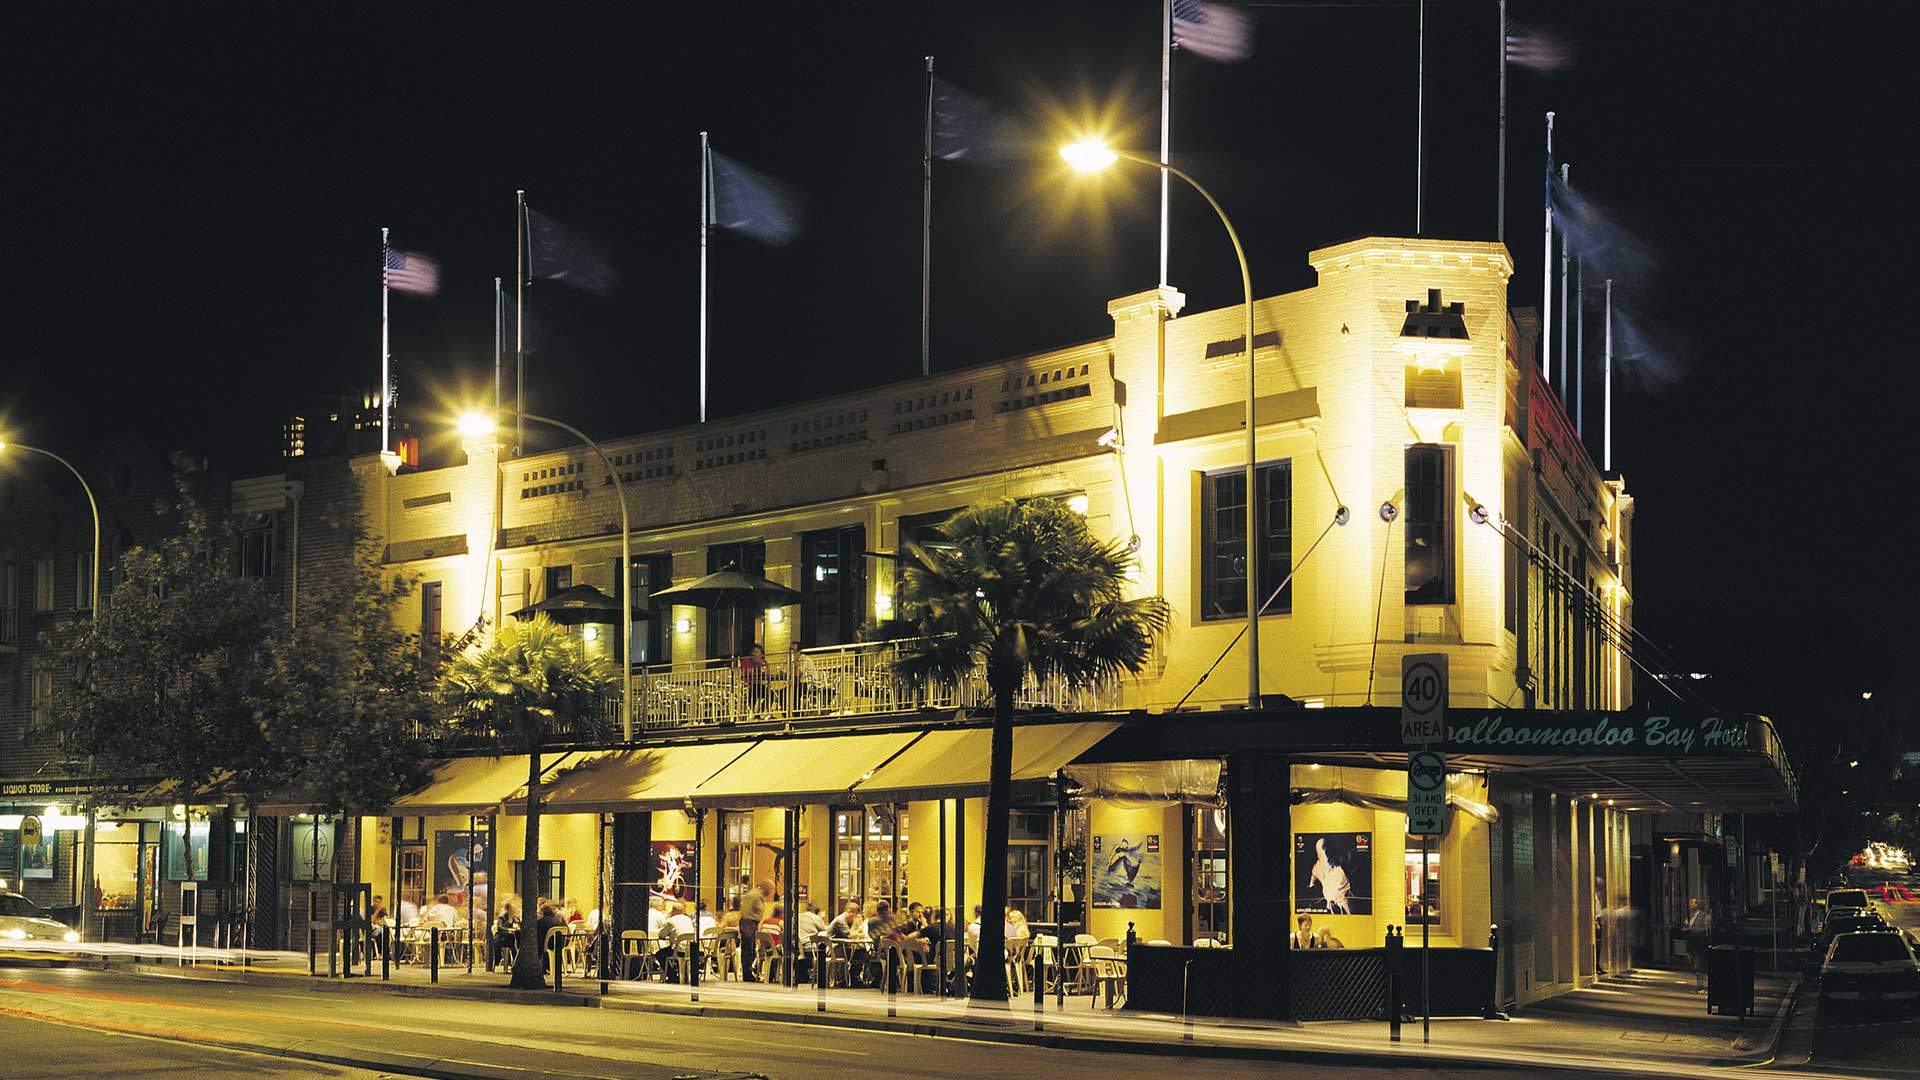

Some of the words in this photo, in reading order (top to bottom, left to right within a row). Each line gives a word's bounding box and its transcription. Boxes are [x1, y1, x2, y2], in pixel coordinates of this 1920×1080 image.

[1408, 675, 1436, 701] 40
[1403, 721, 1441, 737] AREA
[1447, 716, 1636, 745] olloomooloo
[1644, 716, 1695, 753] Bay
[1701, 717, 1749, 747] Hotel
[3, 784, 27, 795] LIQUOR
[28, 783, 50, 794] STORE
[1424, 793, 1442, 804] AND
[1414, 806, 1439, 816] OVER
